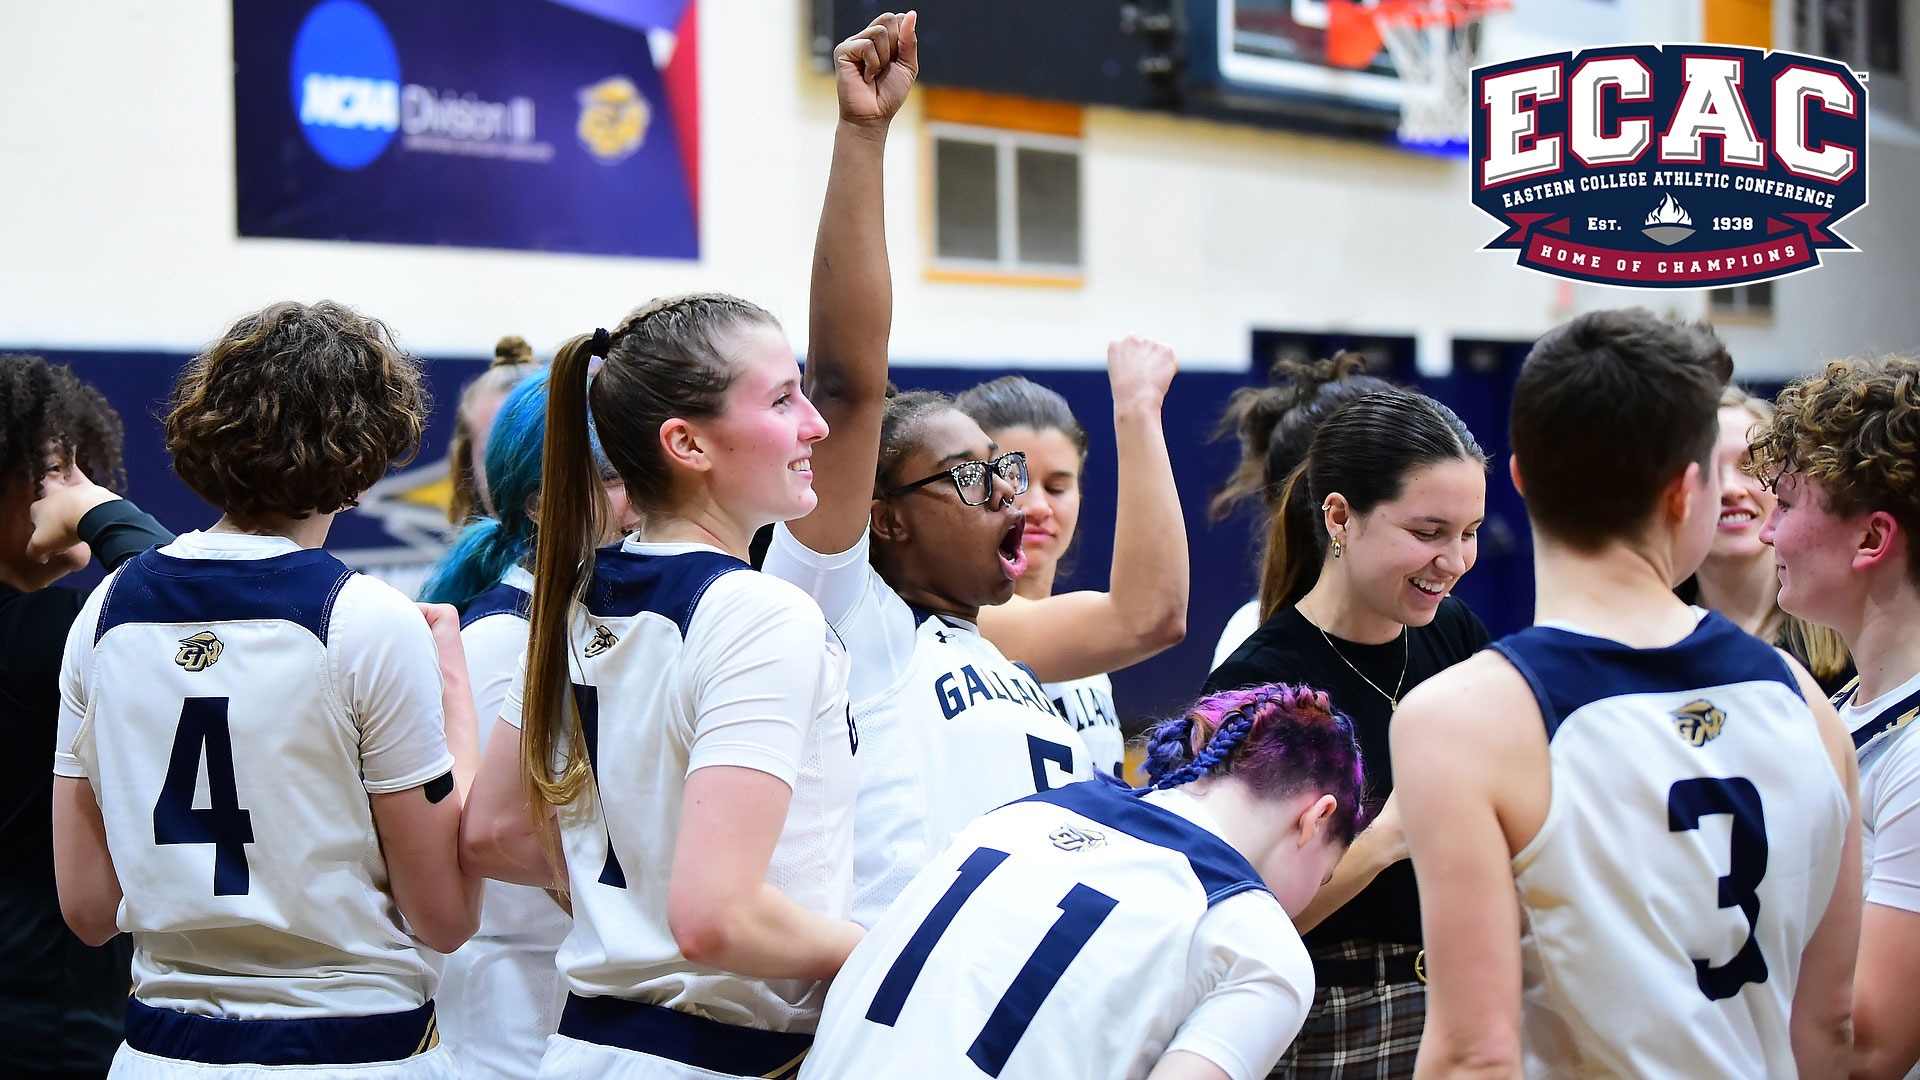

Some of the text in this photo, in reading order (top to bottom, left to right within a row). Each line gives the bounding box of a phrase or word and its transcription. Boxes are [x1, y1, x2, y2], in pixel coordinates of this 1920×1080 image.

[153, 696, 254, 896] 4
[1668, 777, 1769, 1001] 3
[865, 847, 1120, 1079] 11
